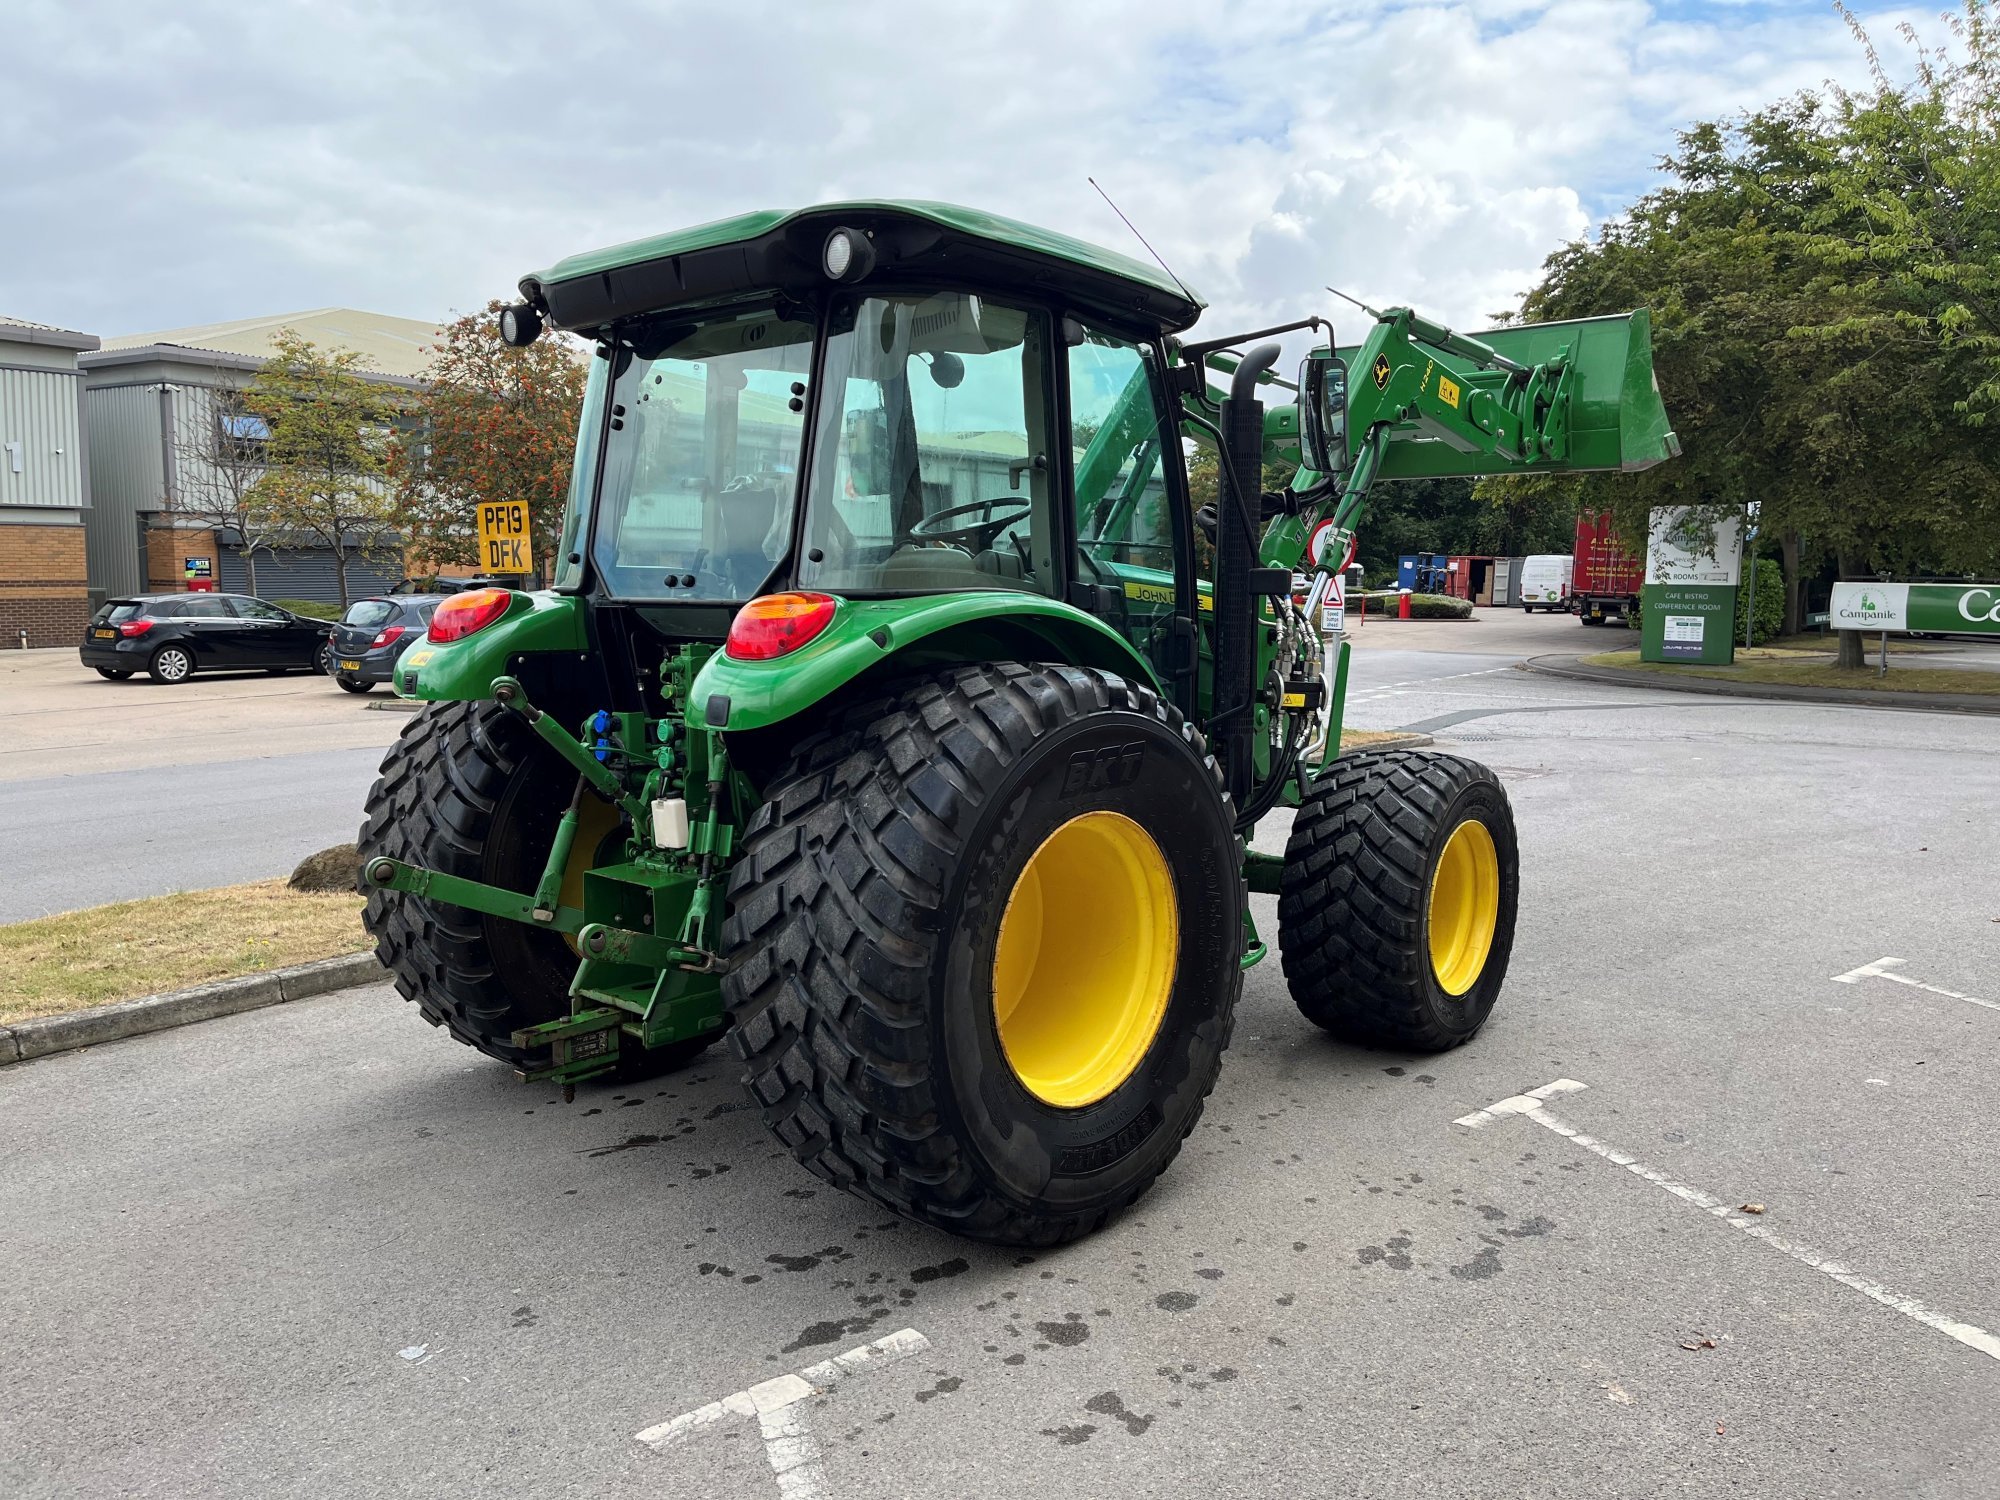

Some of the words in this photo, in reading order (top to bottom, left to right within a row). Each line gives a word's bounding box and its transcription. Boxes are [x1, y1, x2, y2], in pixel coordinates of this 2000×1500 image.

[485, 506, 522, 535] PF19
[489, 539, 523, 567] DFK
[1136, 586, 1167, 602] JOHN
[1665, 592, 1681, 600] CAFE
[1840, 608, 1896, 620] Campanile
